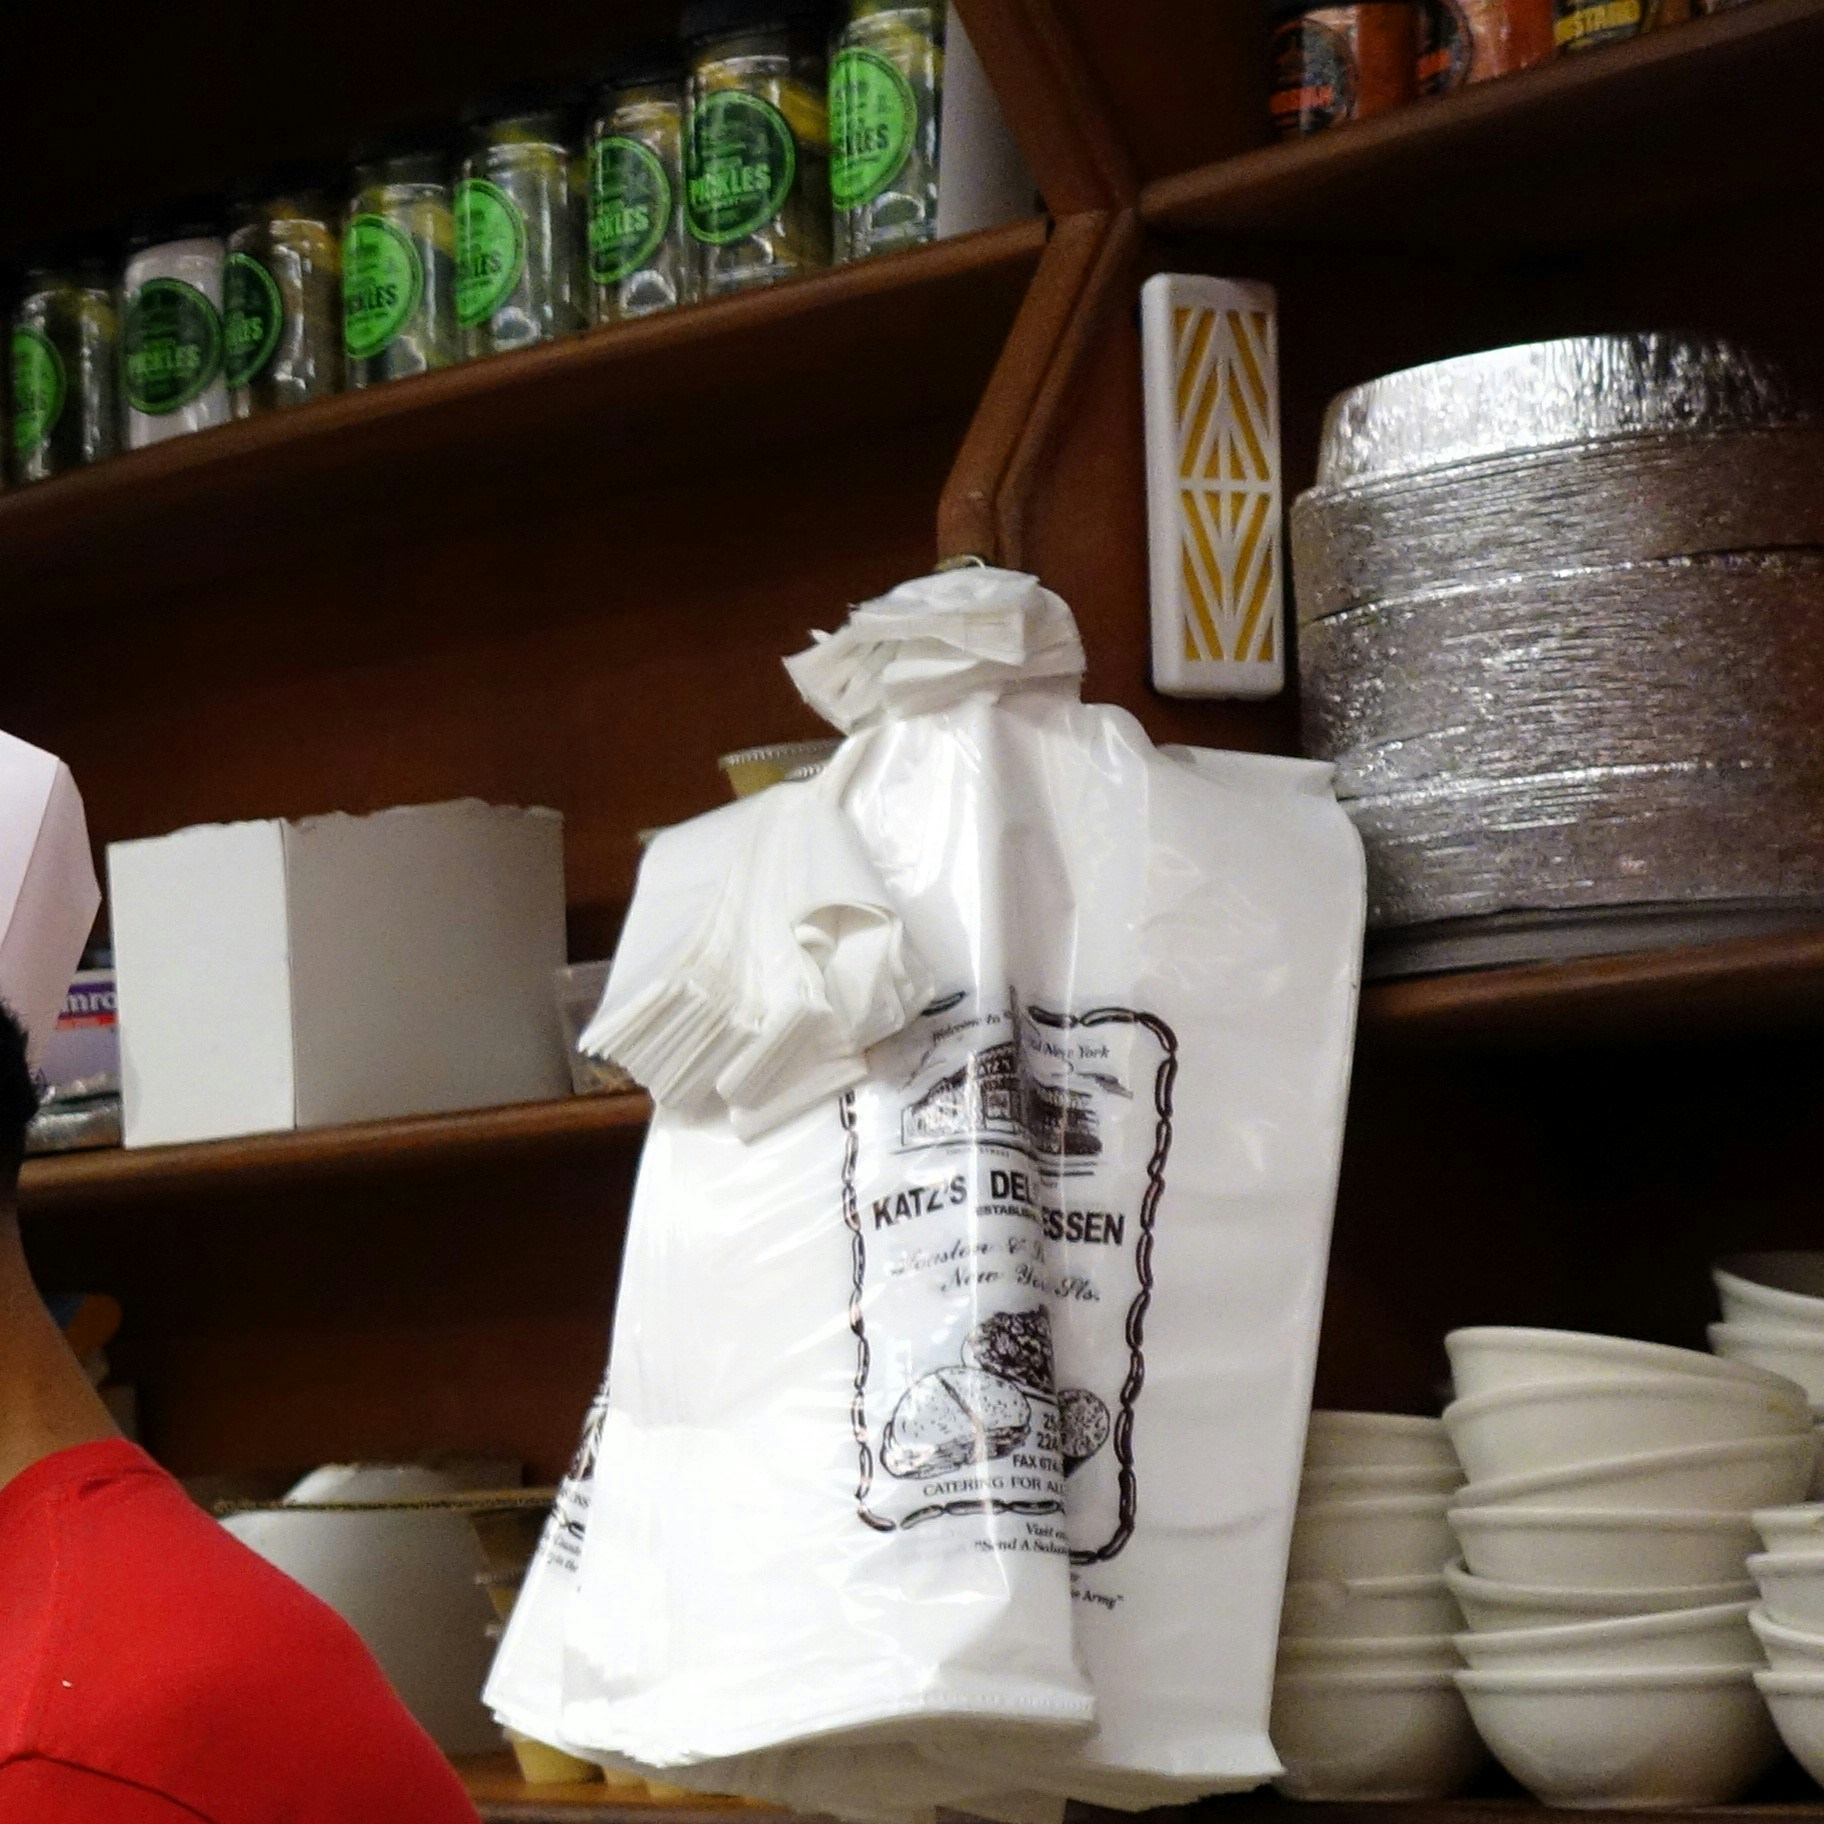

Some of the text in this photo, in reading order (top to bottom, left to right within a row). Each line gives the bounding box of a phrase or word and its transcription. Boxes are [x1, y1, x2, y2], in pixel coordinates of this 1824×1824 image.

[1079, 1044, 1111, 1060] York
[872, 1173, 969, 1232] KATZ'S
[1013, 1453, 1036, 1470] FAX
[923, 1477, 1005, 1497] CATERING
[1010, 1475, 1042, 1492] FOR
